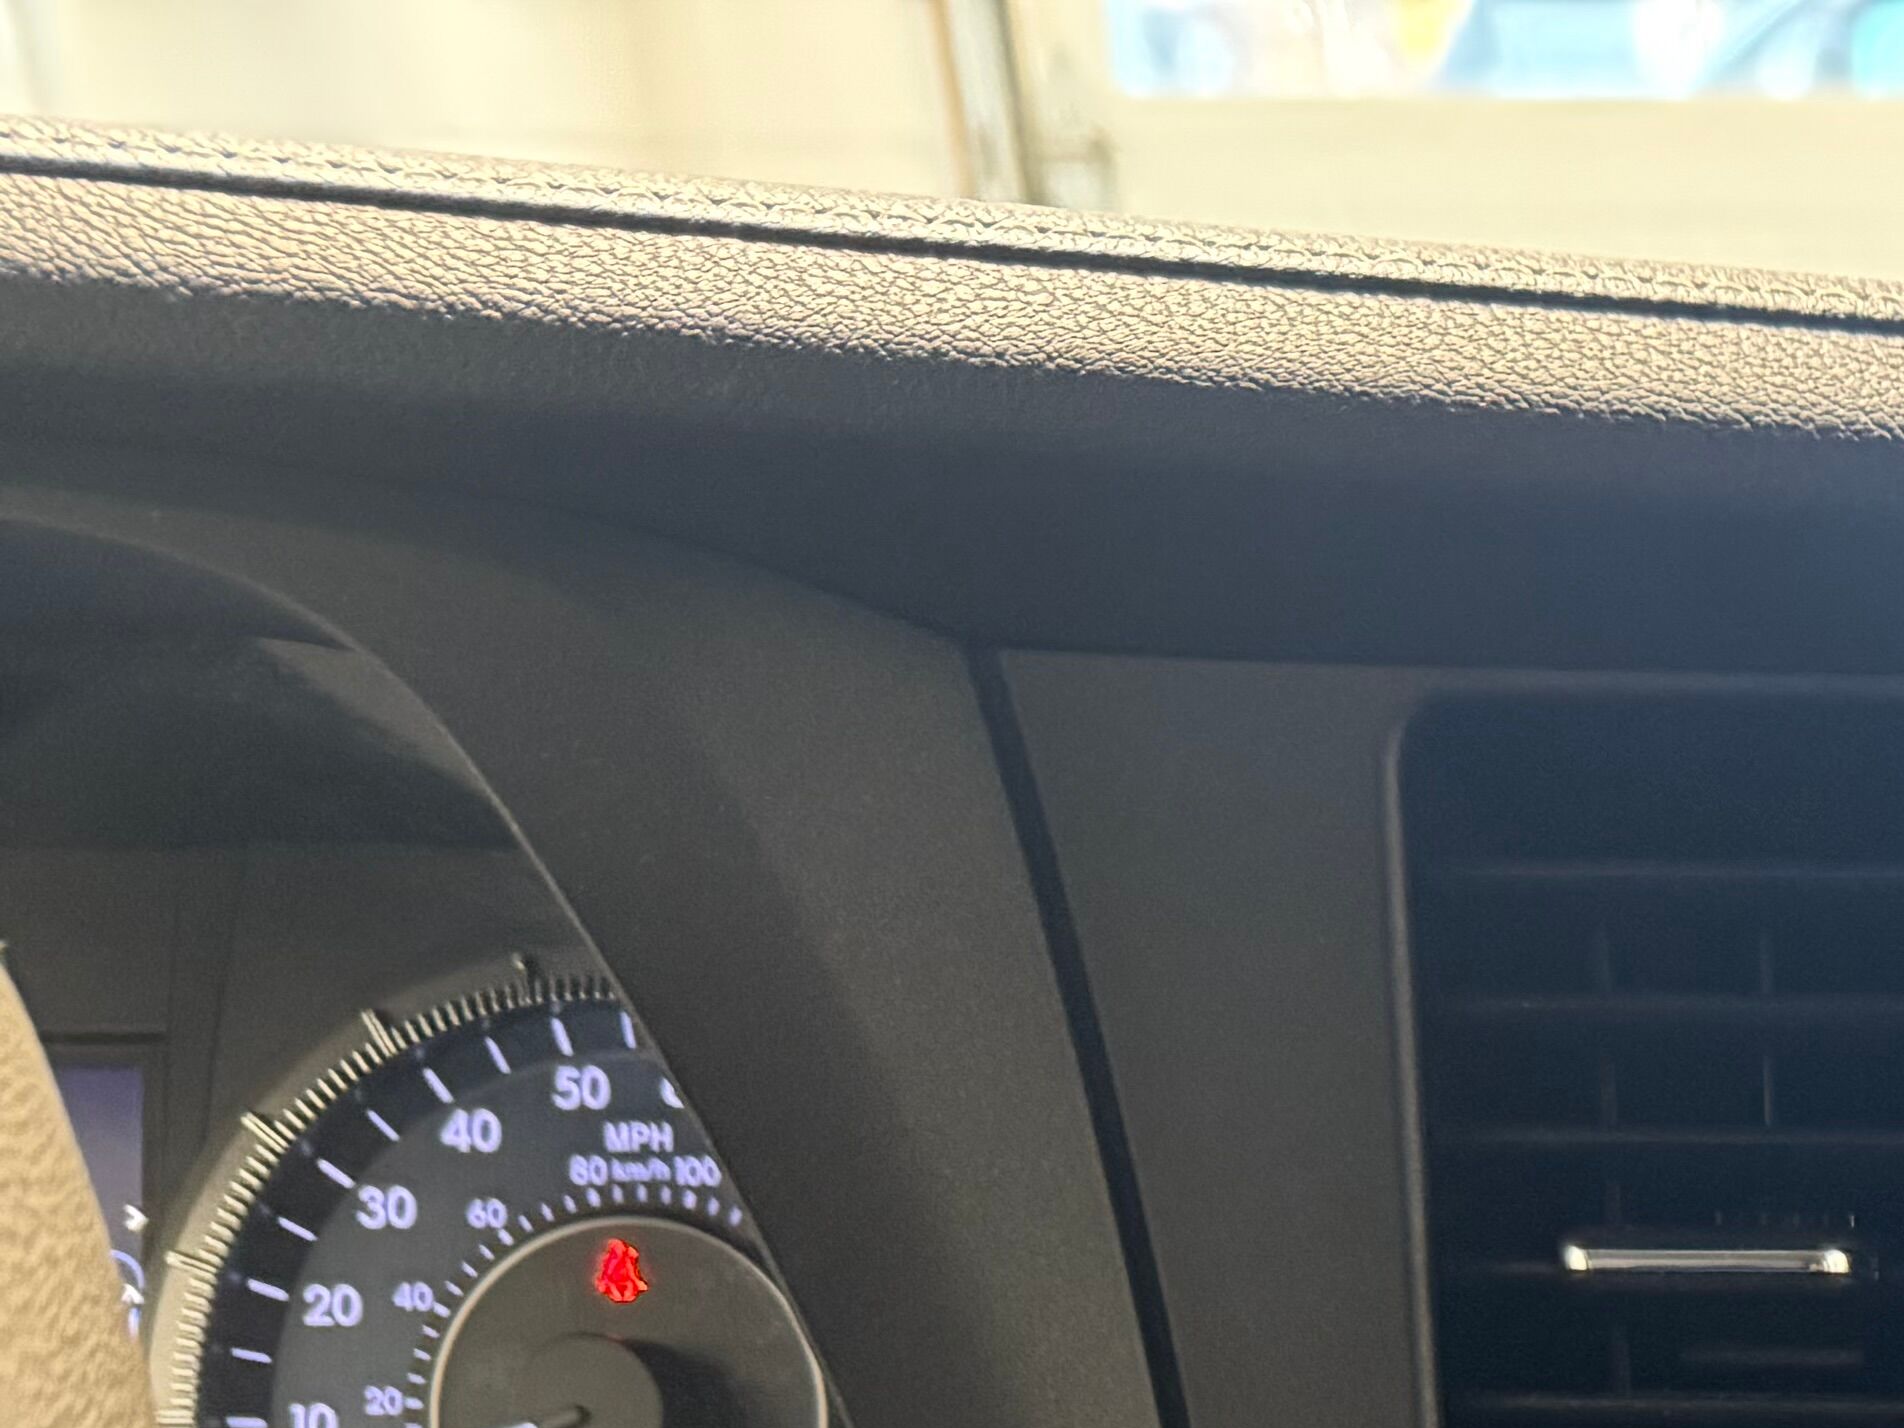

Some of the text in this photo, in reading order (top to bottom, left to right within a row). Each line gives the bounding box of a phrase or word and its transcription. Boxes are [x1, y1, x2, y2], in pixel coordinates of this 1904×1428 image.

[552, 1066, 611, 1110] 50
[440, 1108, 501, 1153] 40
[603, 1122, 674, 1152] MPH
[569, 1155, 608, 1185] 80
[674, 1156, 722, 1186] 100
[356, 1184, 418, 1230] 30
[466, 1198, 508, 1230] 60
[302, 1283, 363, 1327] 20
[392, 1282, 435, 1311] 40
[364, 1386, 403, 1416] 20
